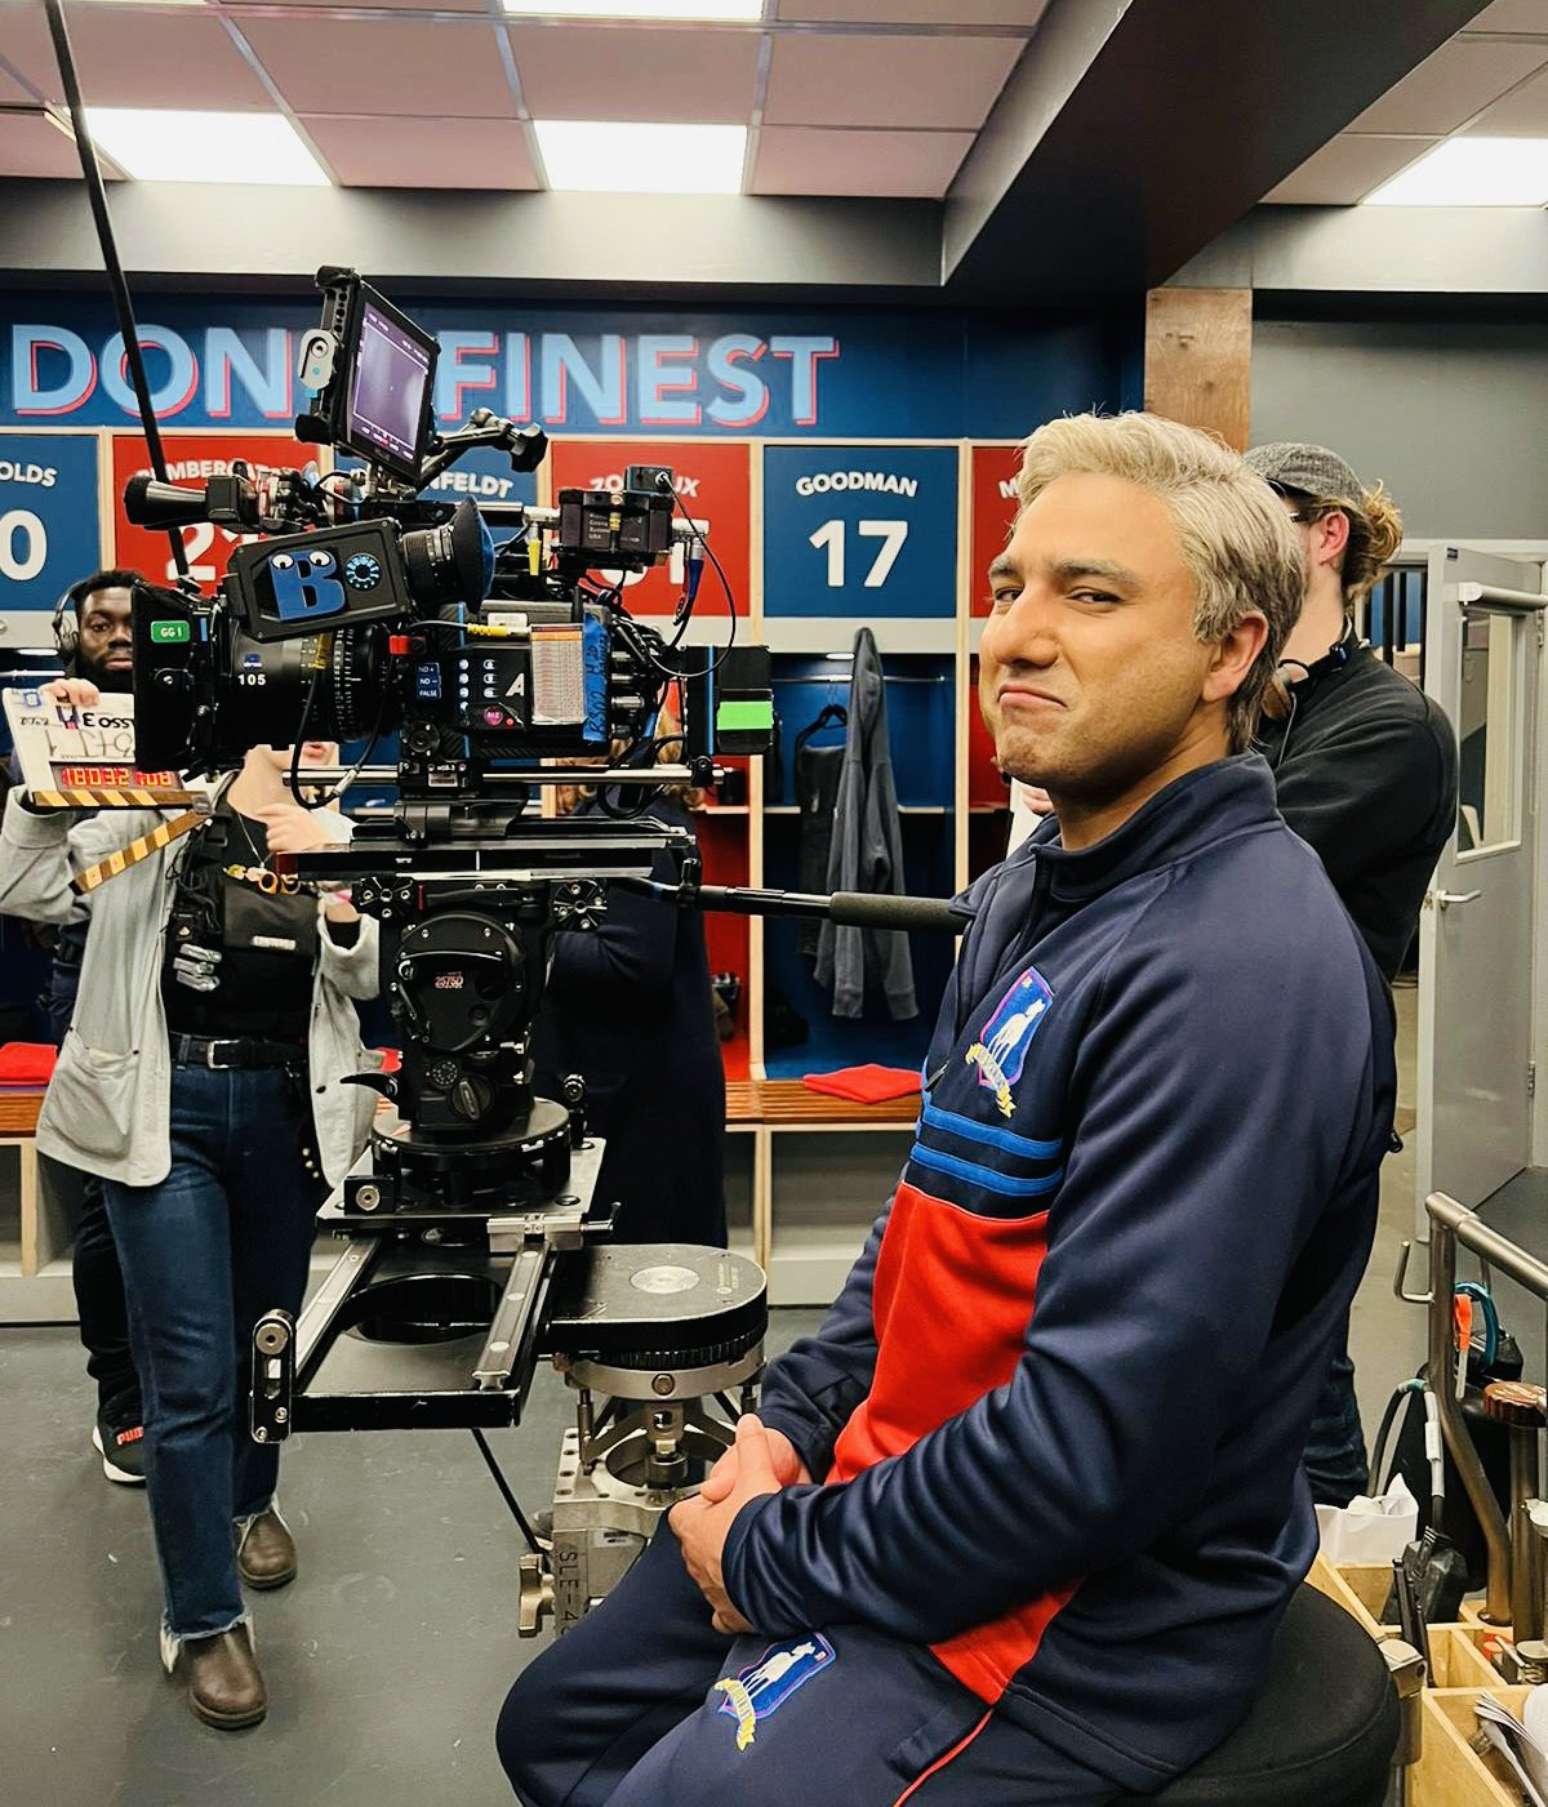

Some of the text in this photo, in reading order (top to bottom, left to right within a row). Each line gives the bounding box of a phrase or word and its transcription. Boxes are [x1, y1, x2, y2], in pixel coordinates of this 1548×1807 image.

[437, 330, 840, 428] FINEST
[796, 471, 918, 498] GOODMAN
[808, 520, 908, 587] 17
[268, 548, 346, 622] B
[238, 674, 267, 686] 105
[505, 673, 525, 697] A
